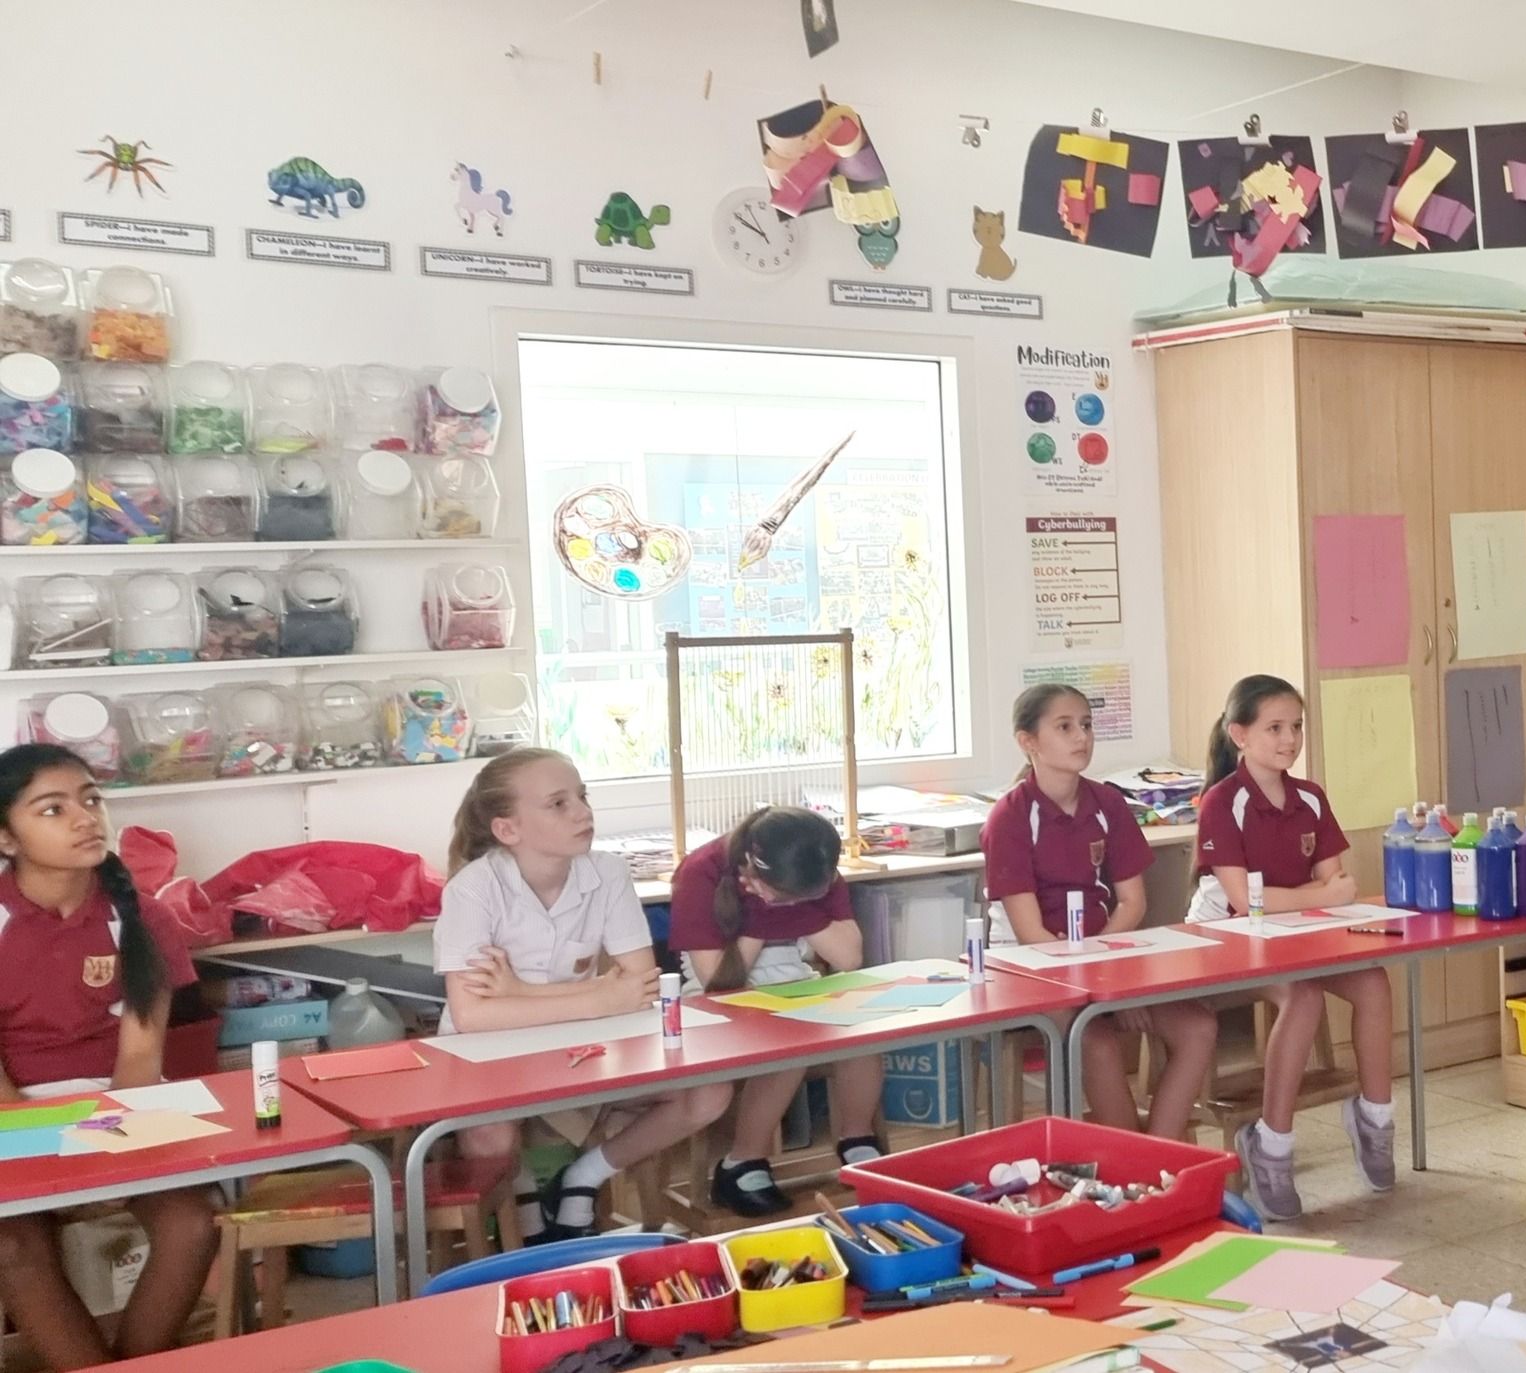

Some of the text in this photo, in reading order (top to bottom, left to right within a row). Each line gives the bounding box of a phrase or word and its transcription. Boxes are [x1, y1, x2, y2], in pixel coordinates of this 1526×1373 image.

[133, 224, 158, 234] have
[161, 227, 189, 237] made
[329, 241, 351, 250] have
[291, 248, 331, 258] different
[486, 257, 506, 265] have
[509, 260, 541, 269] worked
[1017, 344, 1110, 369] Modification
[1038, 519, 1107, 532] Cyberbullying
[1031, 538, 1059, 549] SAVE
[1033, 566, 1069, 577] BLOCK
[1035, 592, 1081, 603] LOG OFF
[1037, 619, 1064, 630] TALK
